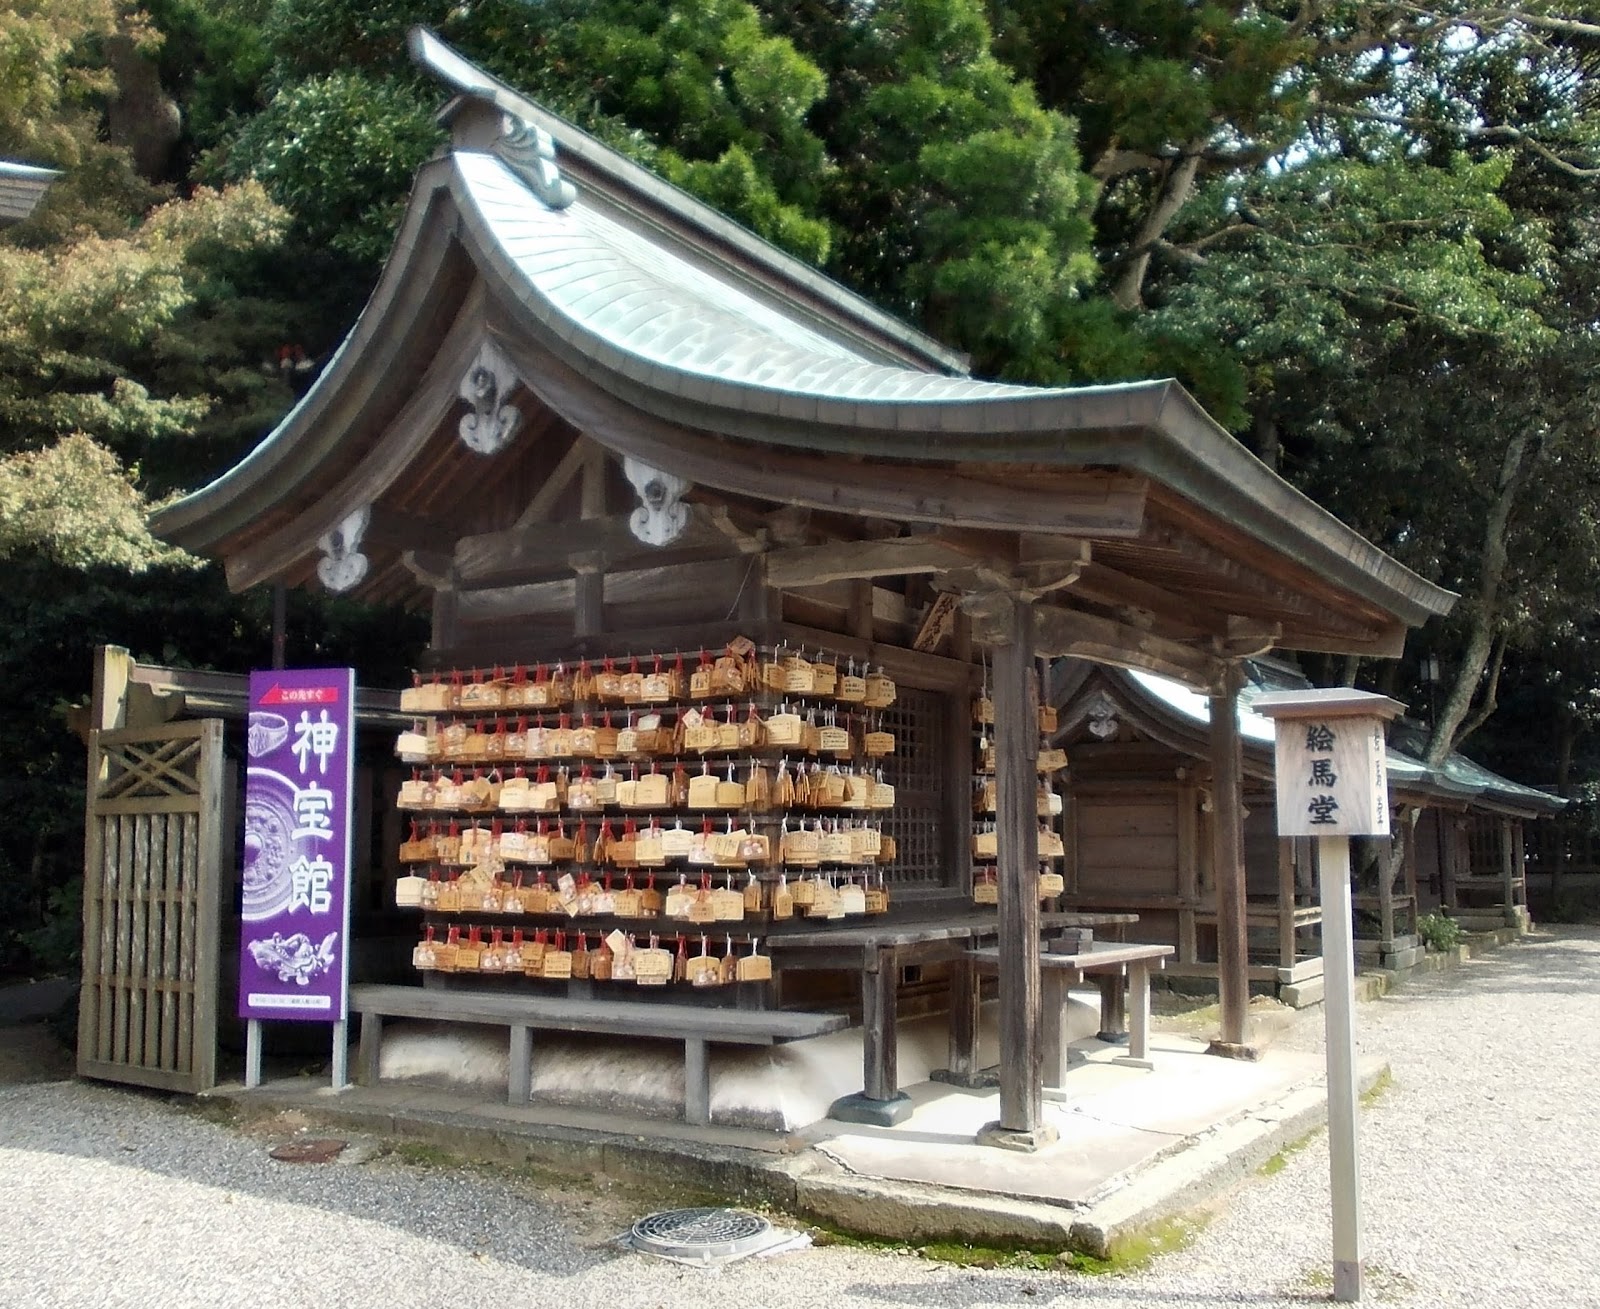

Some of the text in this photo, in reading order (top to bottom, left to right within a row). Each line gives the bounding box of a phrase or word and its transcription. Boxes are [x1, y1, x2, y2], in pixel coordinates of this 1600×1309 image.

[289, 709, 339, 915] 神宝館
[1304, 724, 1339, 825] 絵馬堂
